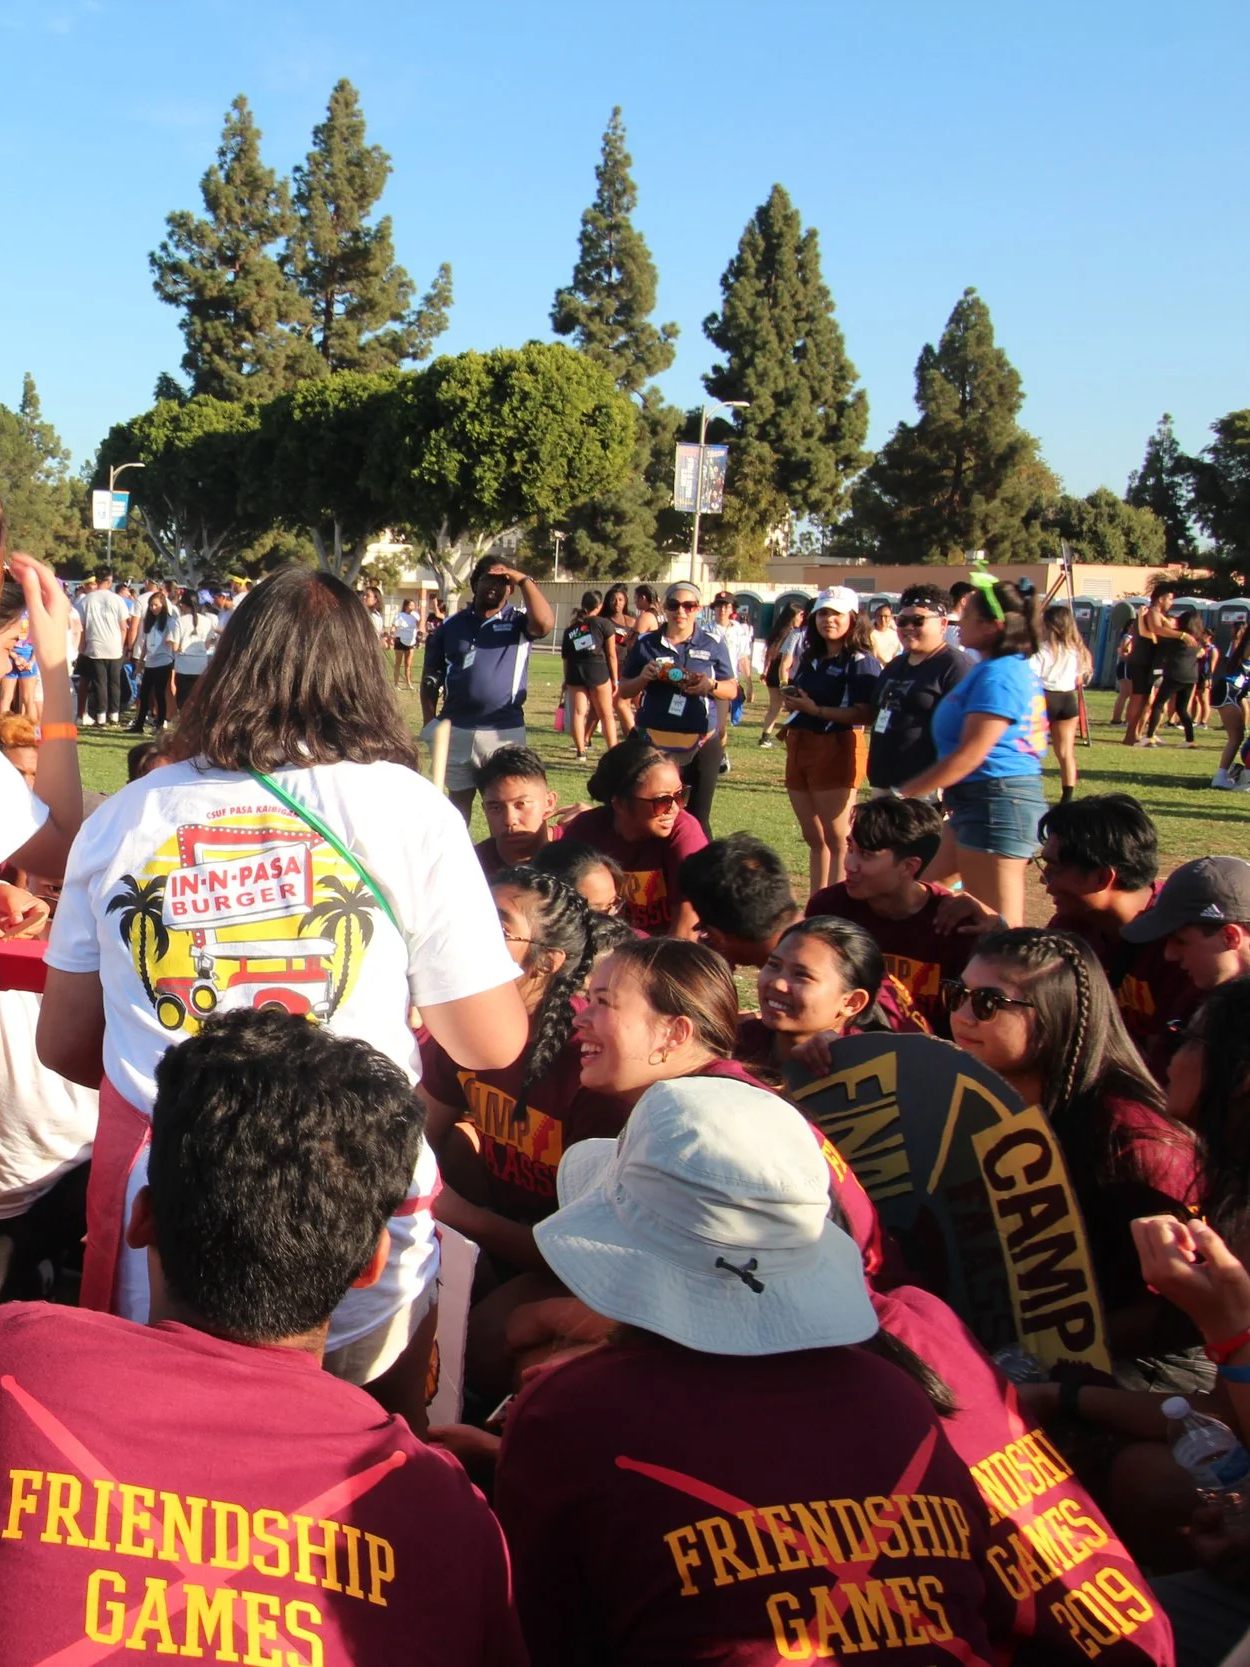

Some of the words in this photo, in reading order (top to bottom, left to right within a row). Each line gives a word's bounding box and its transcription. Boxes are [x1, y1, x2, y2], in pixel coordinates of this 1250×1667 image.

[206, 808, 227, 820] CSUF
[230, 805, 253, 815] PASA
[171, 883, 297, 916] BURGER
[983, 1127, 1096, 1354] CAMP
[1, 1468, 396, 1607] FRIENDSHIP
[664, 1494, 972, 1596] FRIENDSHIP
[987, 1498, 1109, 1602] GAMES
[85, 1568, 325, 1667] GAMES
[766, 1575, 954, 1660] GAMES
[1051, 1566, 1155, 1660] 2019
